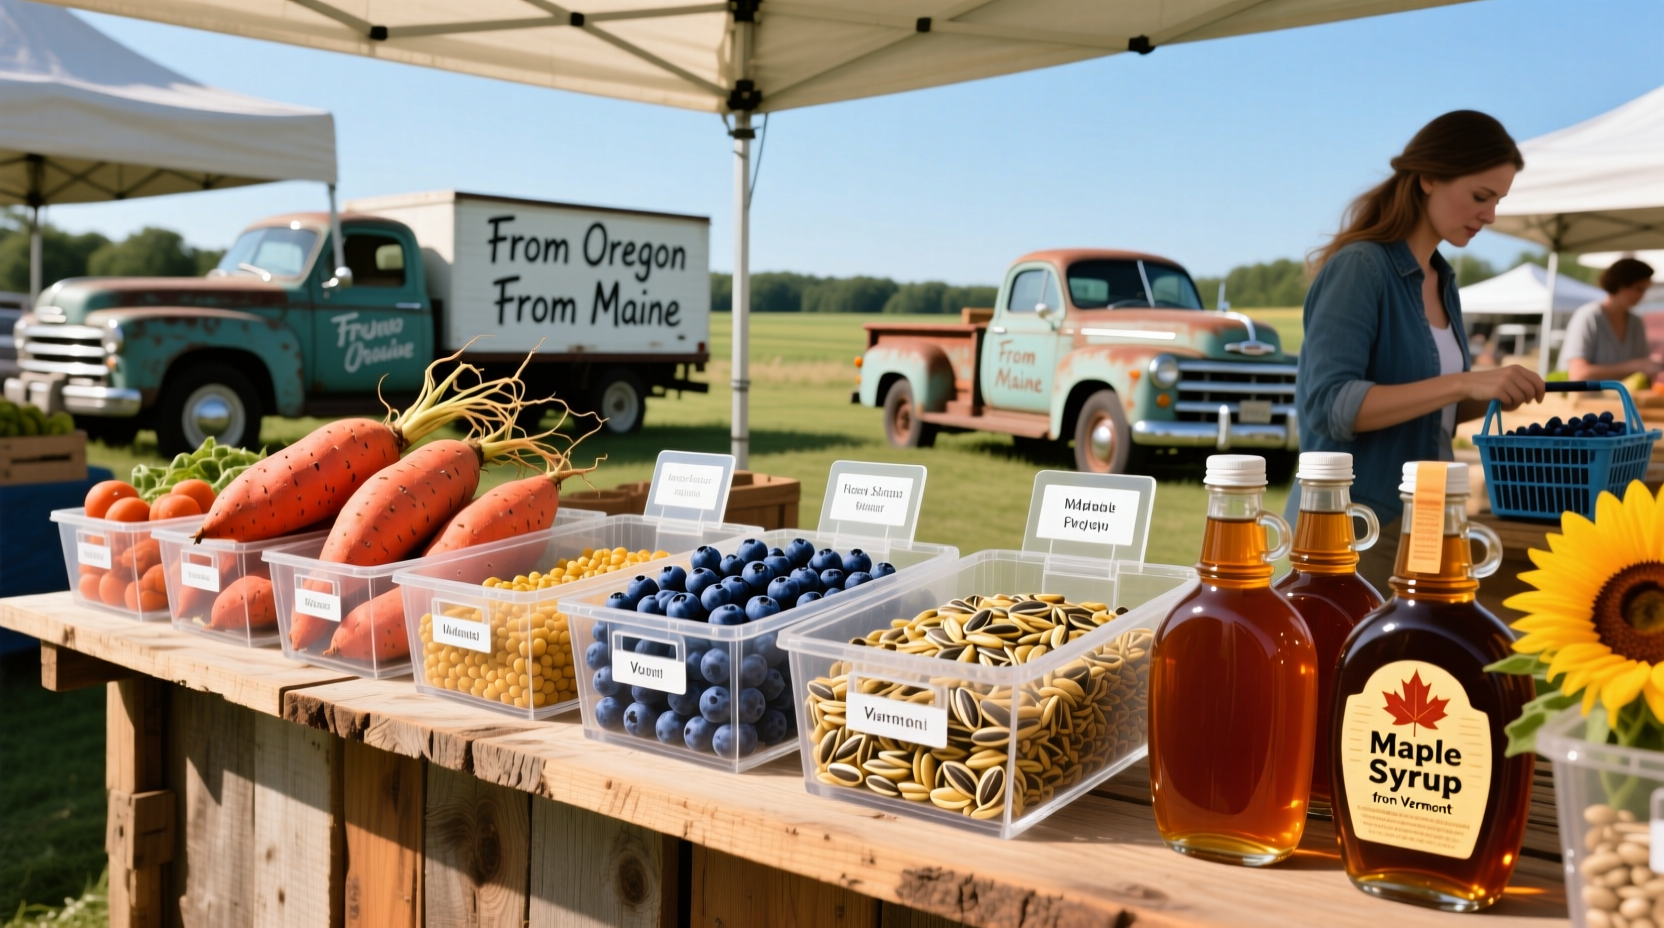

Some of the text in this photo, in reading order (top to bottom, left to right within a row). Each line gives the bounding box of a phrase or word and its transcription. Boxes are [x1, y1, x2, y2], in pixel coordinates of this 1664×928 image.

[487, 215, 686, 283] From Oregon
[492, 275, 682, 327] From Maine
[998, 339, 1036, 366] From
[995, 367, 1042, 393] Maine
[1370, 730, 1462, 767] Maple
[1368, 758, 1462, 800] Syrup
[1400, 795, 1454, 815] Vermont
